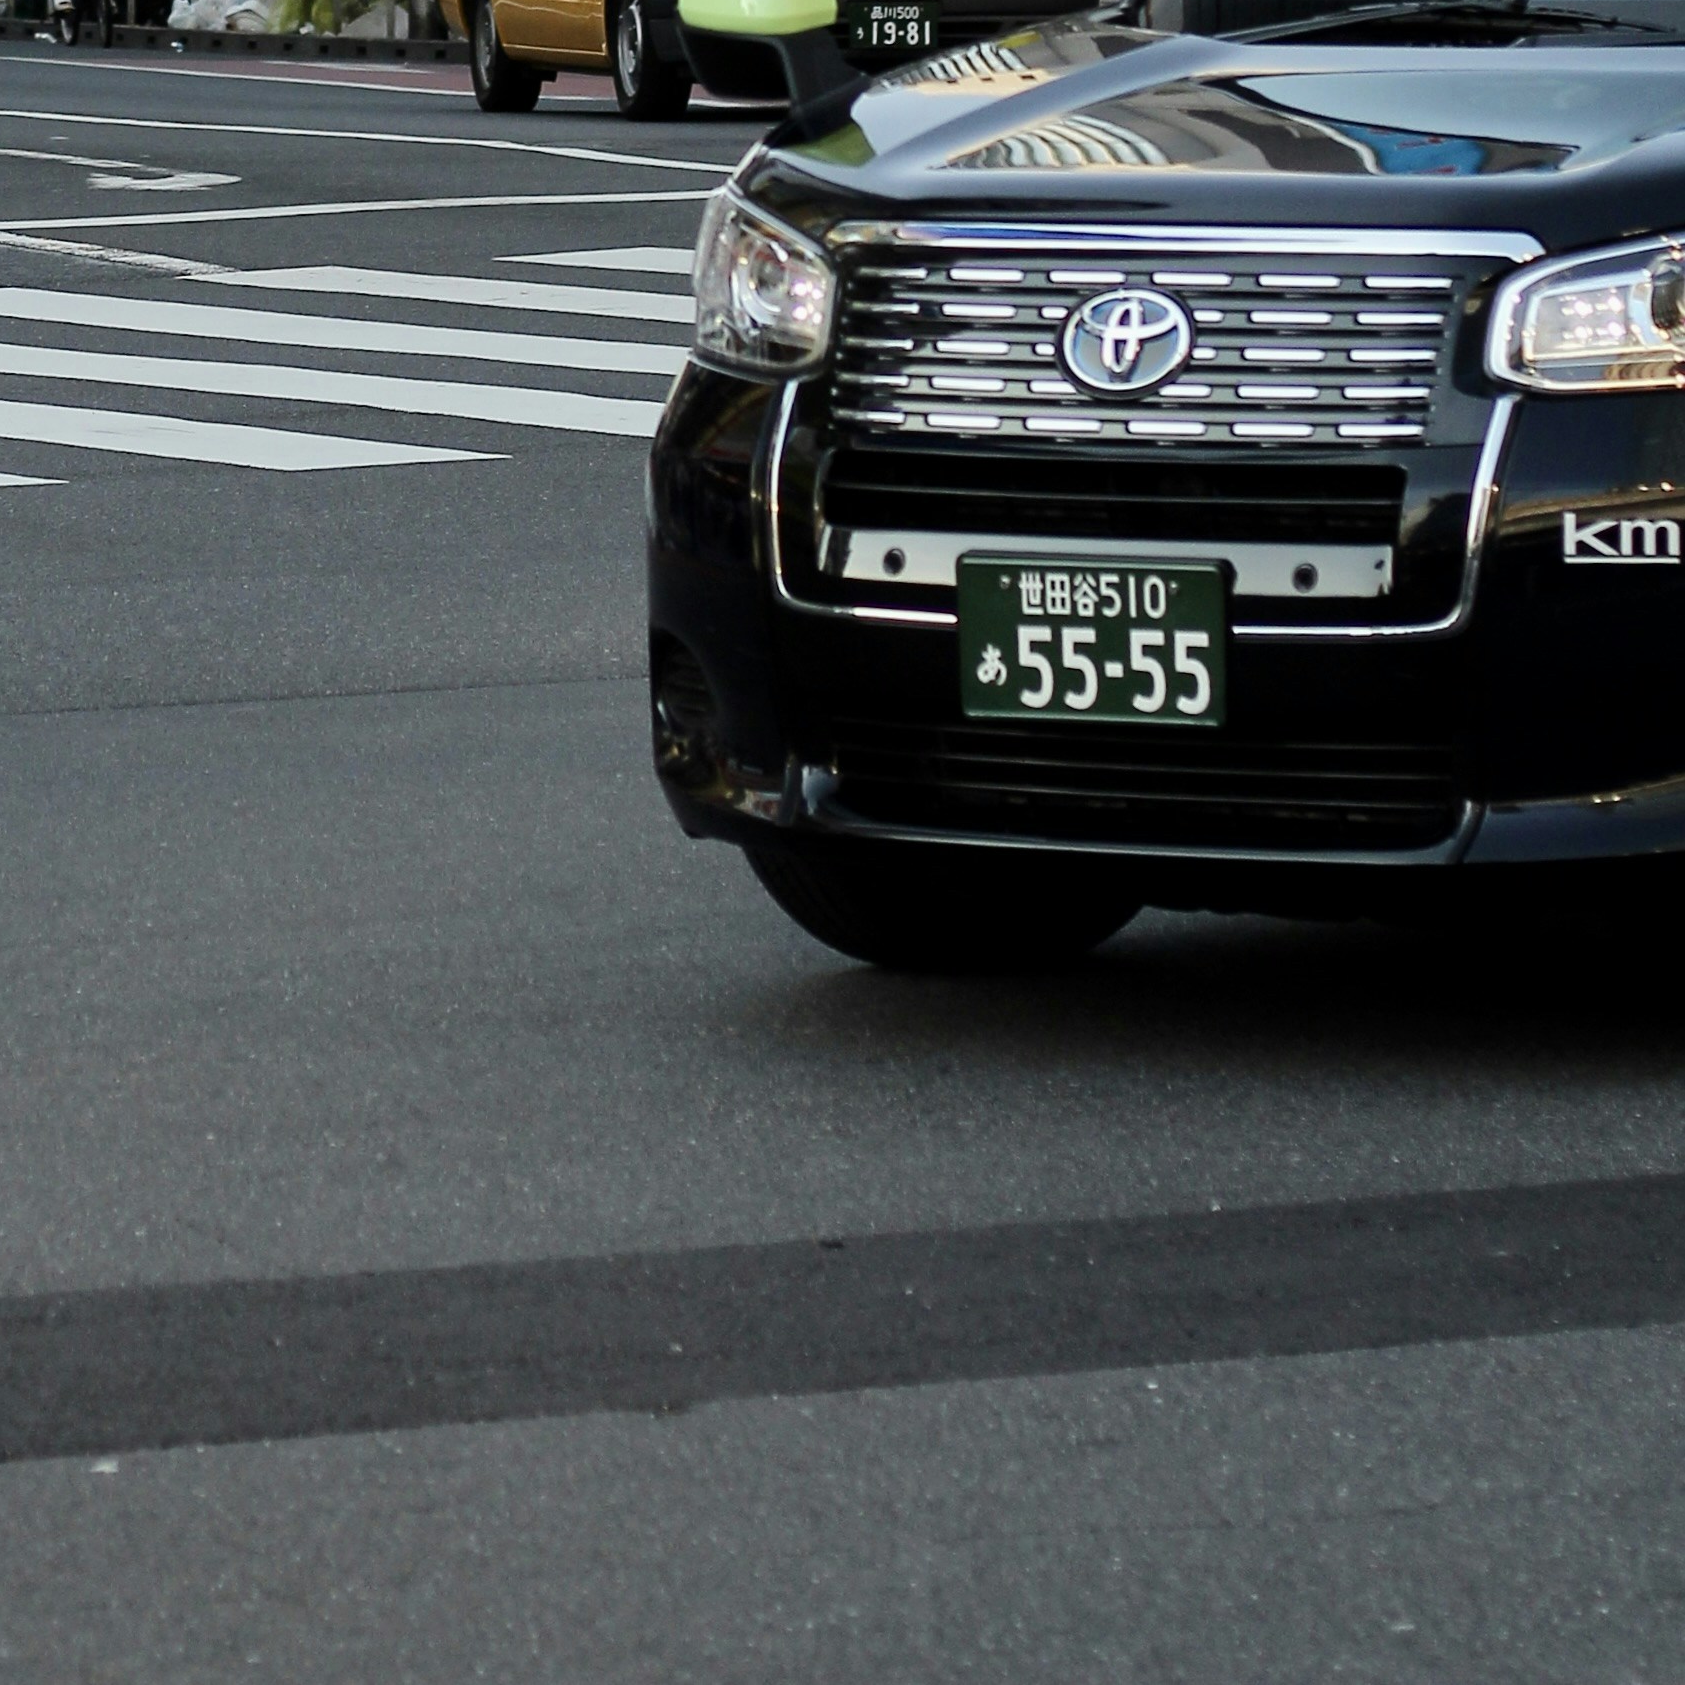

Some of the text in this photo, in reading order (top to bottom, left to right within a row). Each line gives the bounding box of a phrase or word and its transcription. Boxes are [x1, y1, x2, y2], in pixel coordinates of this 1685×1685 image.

[872, 21, 931, 46] 19-81
[1563, 511, 1681, 557] km
[976, 624, 1212, 716] あ 55-55
